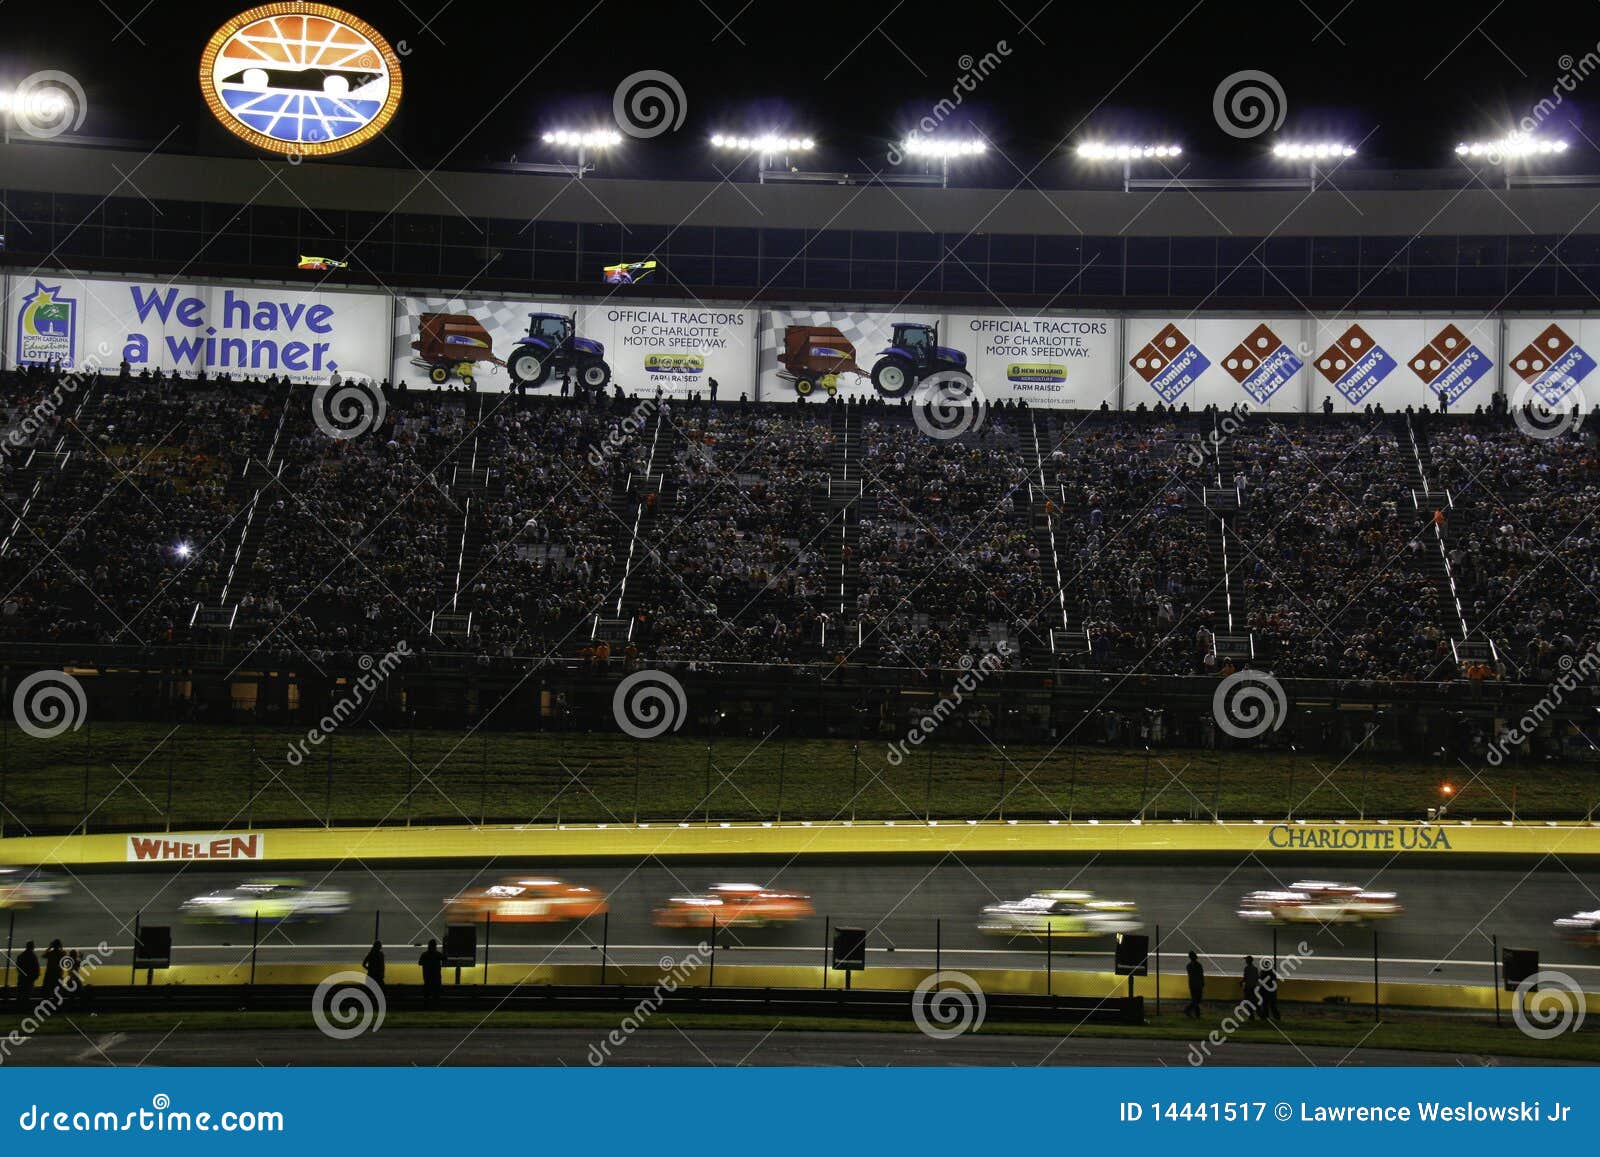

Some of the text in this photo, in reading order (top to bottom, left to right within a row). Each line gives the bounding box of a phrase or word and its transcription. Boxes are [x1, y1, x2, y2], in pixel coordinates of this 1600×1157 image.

[130, 286, 335, 334] We have
[607, 311, 744, 326] OFFICIAL TRACTORS
[631, 326, 719, 338] OF CHARLOTTE
[970, 319, 1107, 335] OFFICIAL TRACTORS
[122, 326, 338, 373] a winner.
[623, 336, 665, 347] MOTOR
[986, 346, 1028, 356] MOTOR
[994, 335, 1082, 347] OF CHARLOTTE
[23, 350, 68, 360] LOTTERY
[1153, 350, 1199, 393] Domino's
[1337, 351, 1384, 395] Domino's
[1163, 375, 1192, 401] Pizza
[1255, 375, 1285, 402] Pizza
[1347, 375, 1378, 403] Pizza
[131, 834, 257, 860] WHELEN
[1398, 827, 1452, 849] USA
